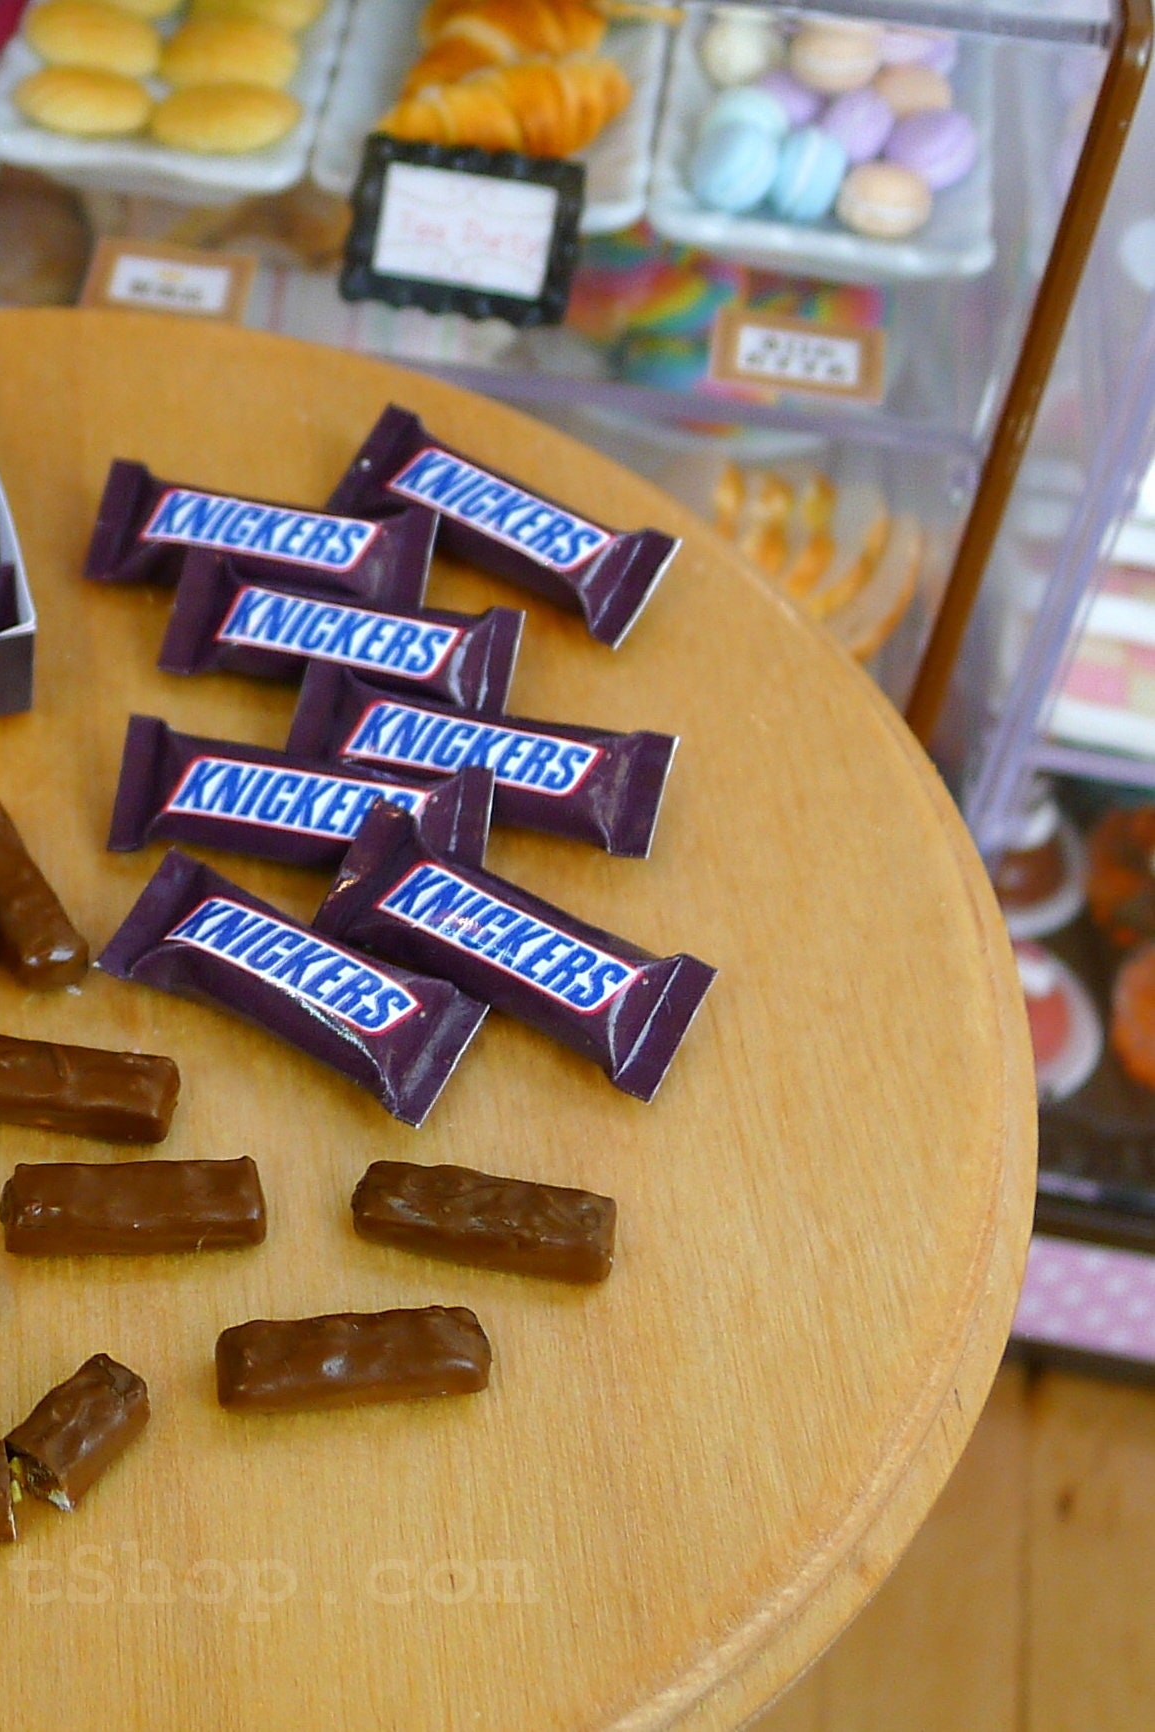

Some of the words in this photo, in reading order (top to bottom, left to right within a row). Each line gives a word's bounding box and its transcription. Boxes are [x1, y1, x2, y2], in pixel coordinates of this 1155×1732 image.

[152, 494, 369, 566] KNICKERS
[398, 450, 602, 566] KNICKERS
[224, 590, 452, 675] KNICKERS
[349, 705, 591, 791] KNICKERS
[175, 902, 411, 1030] KNICKERS
[384, 866, 630, 1009] KNICKERS
